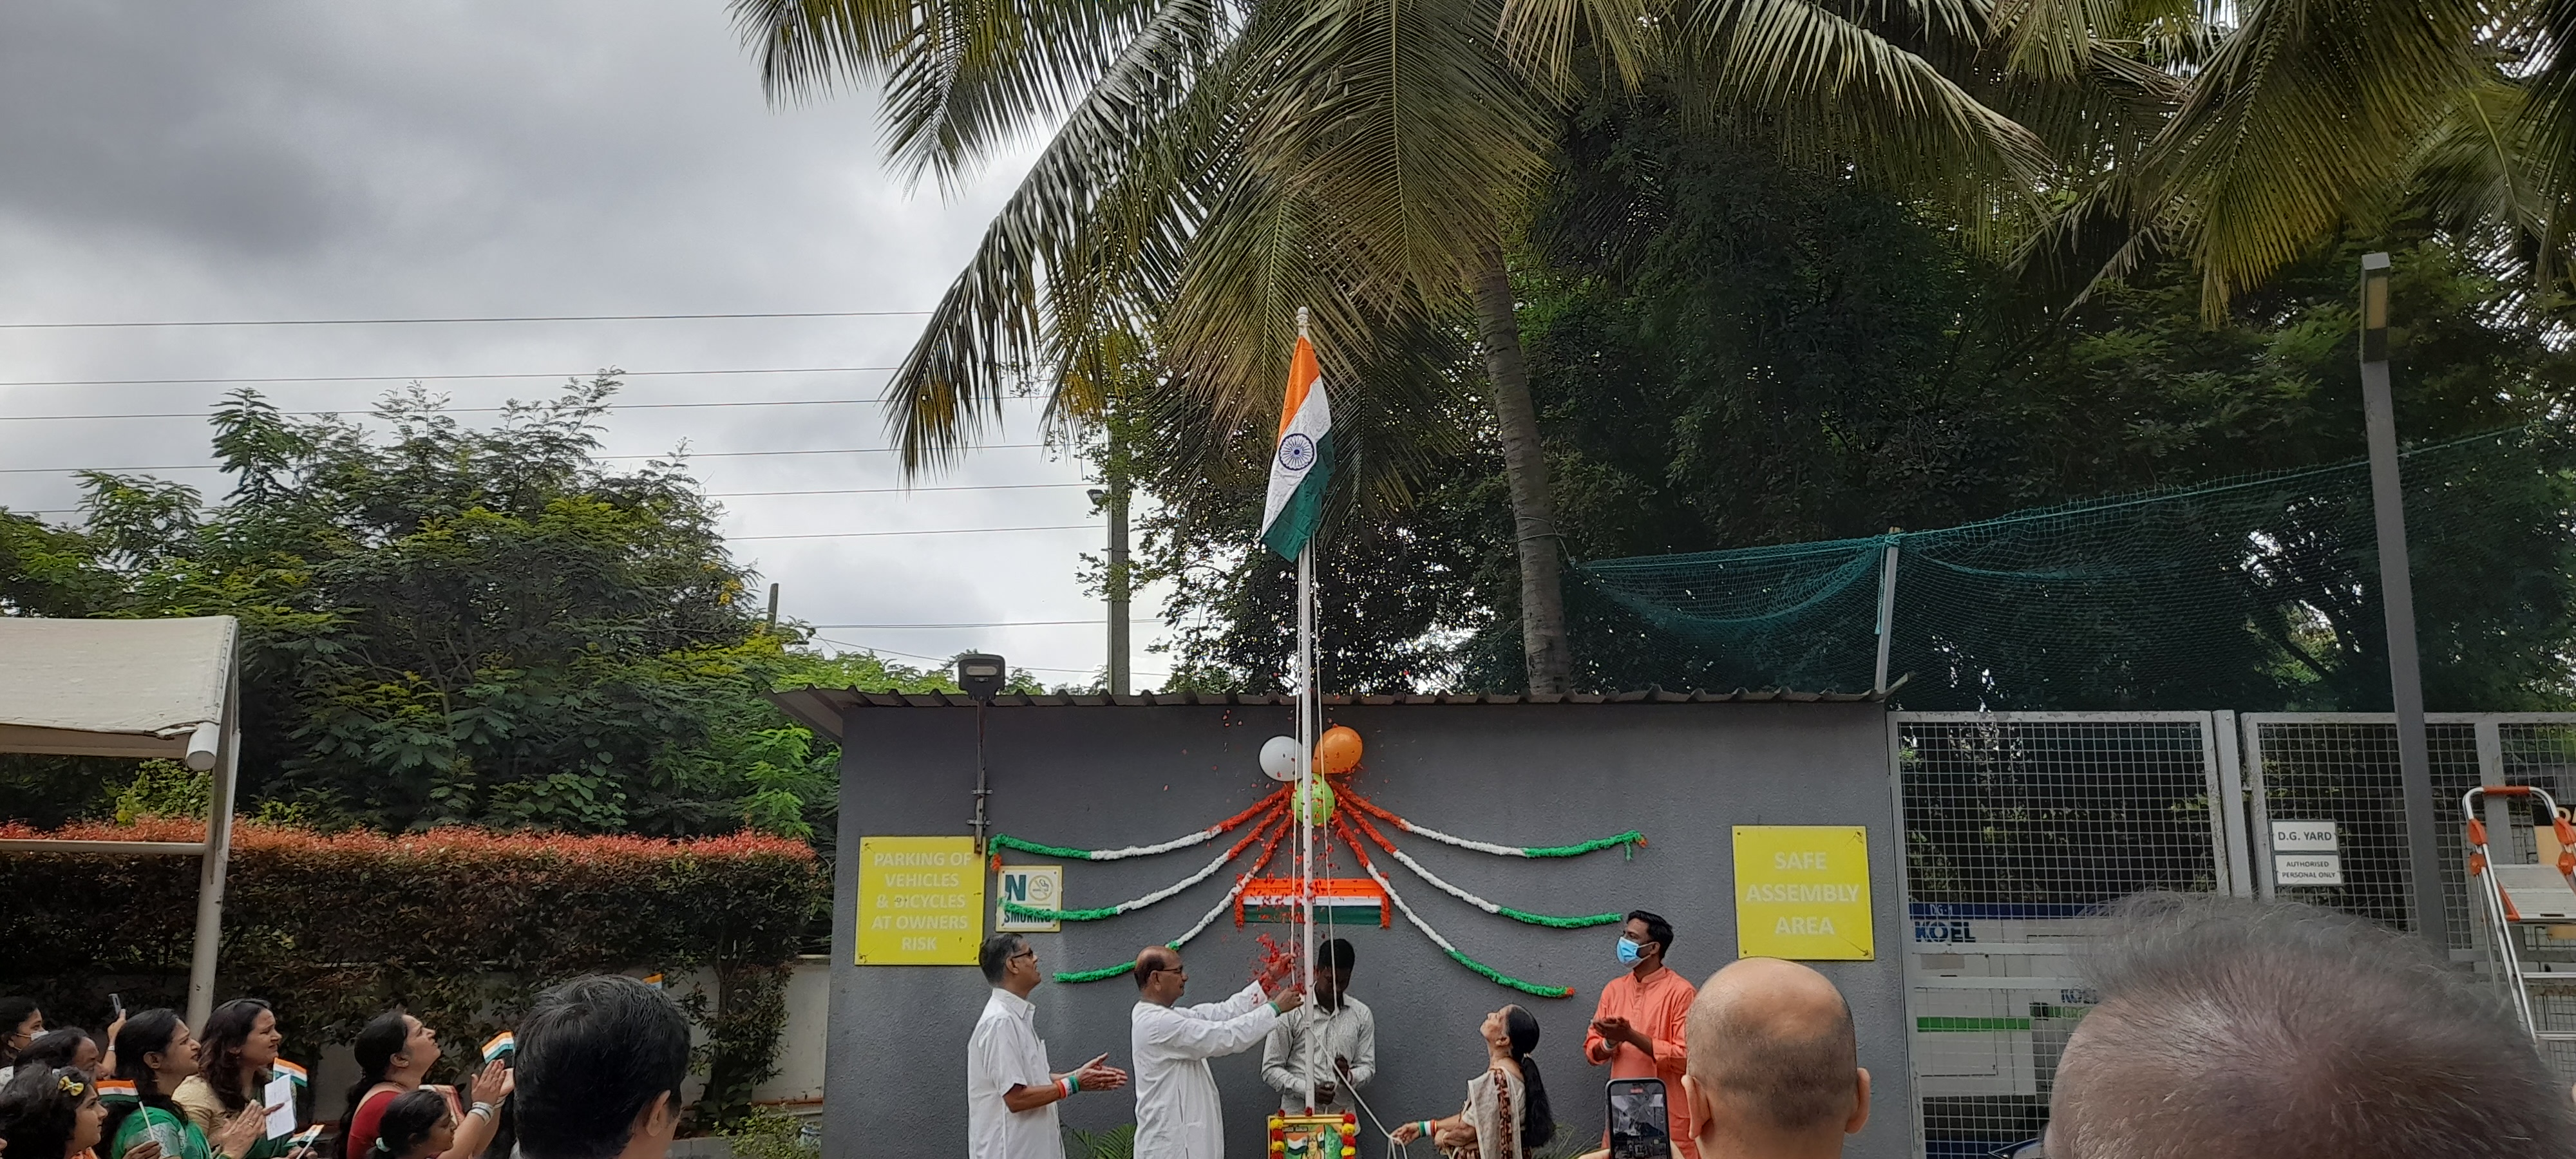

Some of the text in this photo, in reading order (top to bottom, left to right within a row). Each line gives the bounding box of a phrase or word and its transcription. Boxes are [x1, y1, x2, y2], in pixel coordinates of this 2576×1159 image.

[2556, 807, 2576, 824] D
[2278, 831, 2332, 841] D.G. YARD
[874, 852, 972, 866] PARKING OF
[1774, 851, 1828, 870] SAFE
[885, 873, 960, 887] VEHICLES
[1745, 883, 1860, 902] ASSEMBLY
[876, 894, 966, 908] & BICYCLES
[871, 915, 967, 929] AT OWNERS
[1775, 916, 1835, 934] AREA
[1915, 921, 1976, 943] KOEL
[902, 936, 937, 950] RISK
